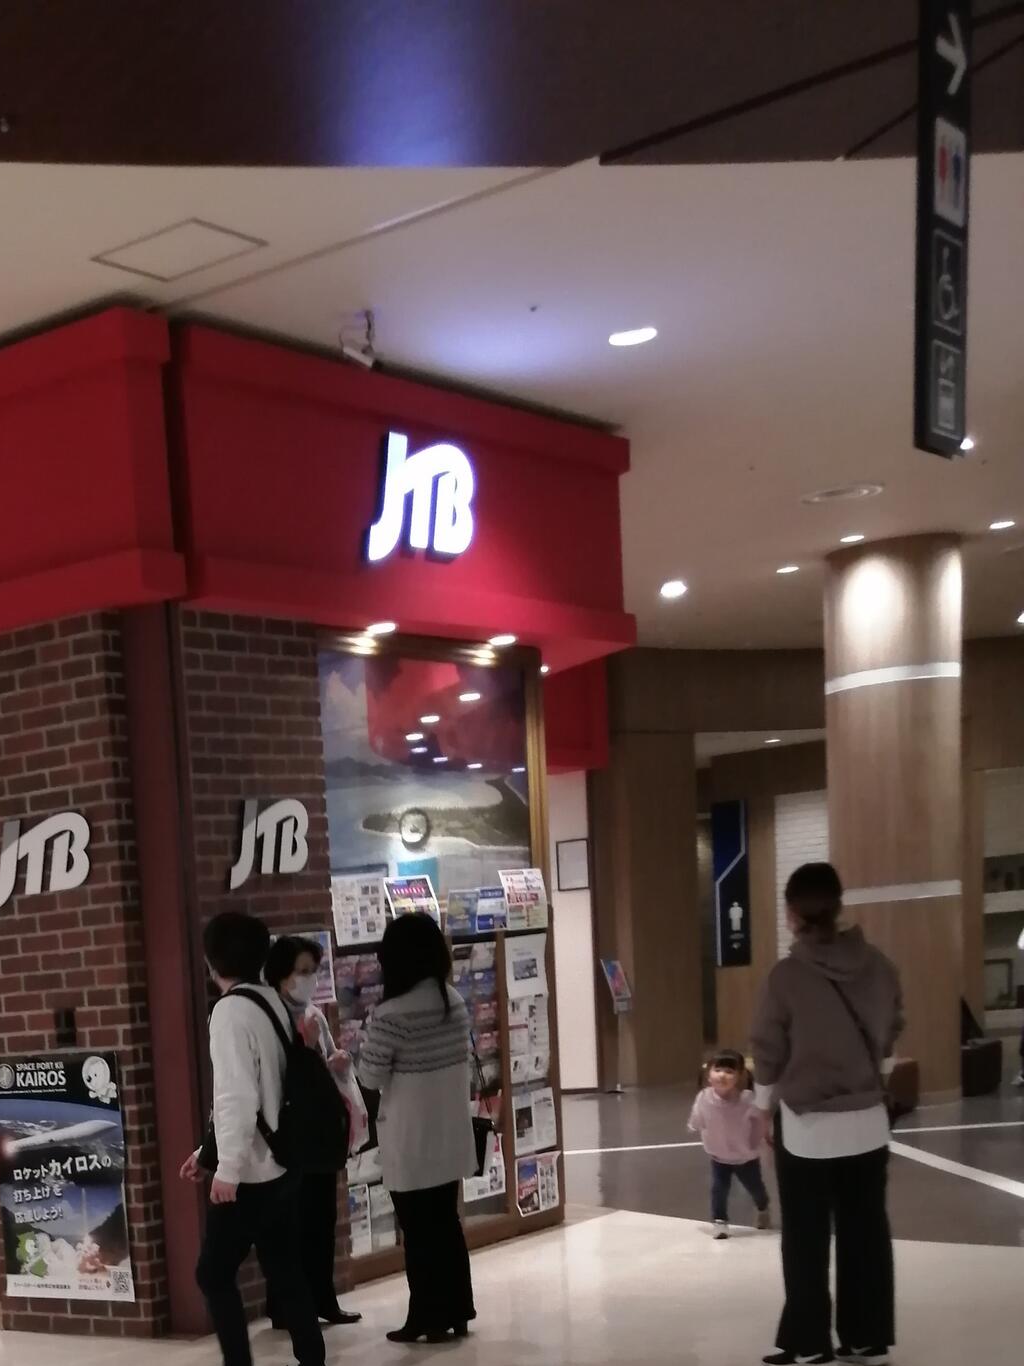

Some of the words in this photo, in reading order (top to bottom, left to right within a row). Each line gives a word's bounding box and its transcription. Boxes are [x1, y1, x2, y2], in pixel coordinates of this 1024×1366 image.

[368, 431, 474, 560] JTB
[230, 798, 308, 890] JTB
[16, 1063, 36, 1072] SPACE
[36, 1062, 54, 1070] PORT
[16, 1070, 67, 1088] KAIROS
[13, 1154, 112, 1181] ロケットカイロスの
